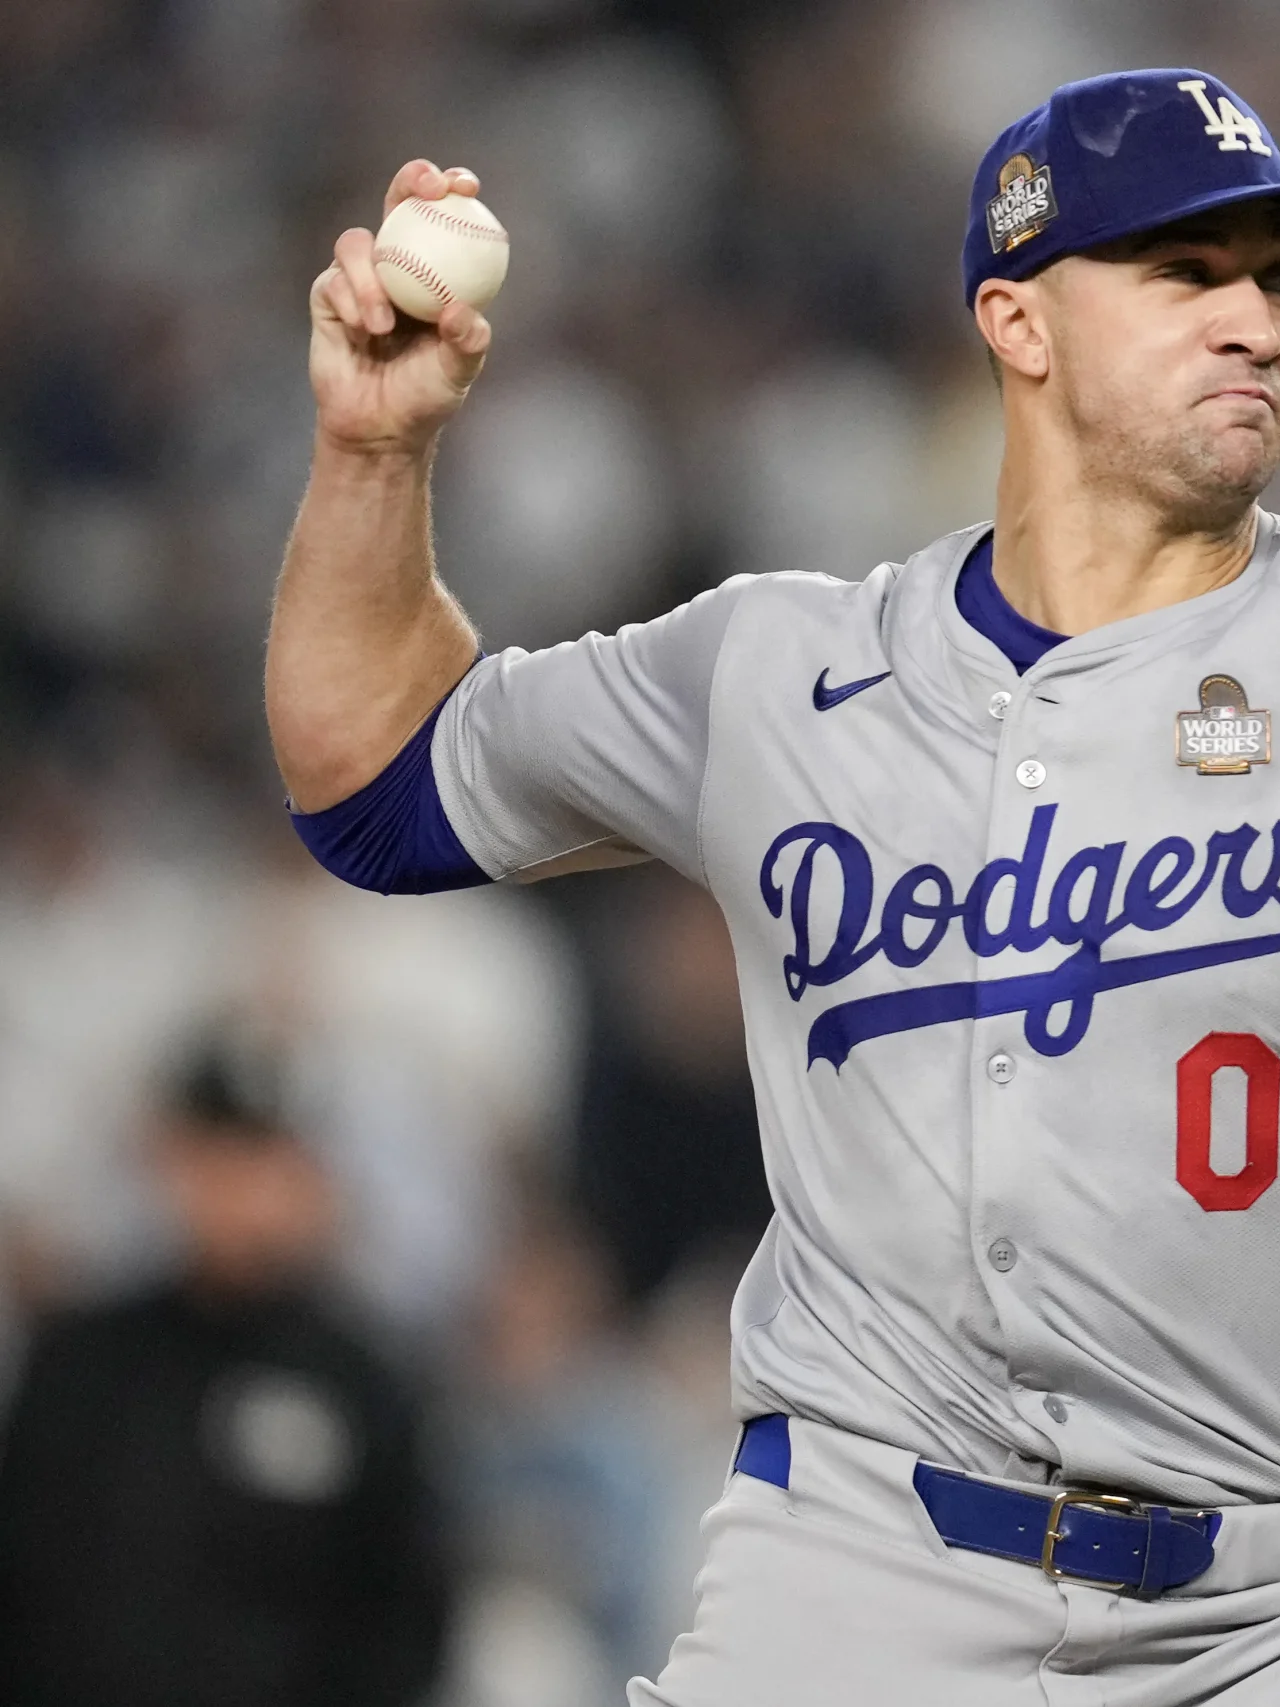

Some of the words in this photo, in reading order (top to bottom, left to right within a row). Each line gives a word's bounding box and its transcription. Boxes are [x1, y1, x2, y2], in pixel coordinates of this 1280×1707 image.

[1177, 80, 1272, 157] LA
[991, 177, 1048, 221] WORLD
[995, 194, 1049, 237] SERIES
[1183, 719, 1263, 738] WORLD
[1186, 736, 1260, 755] SERIES
